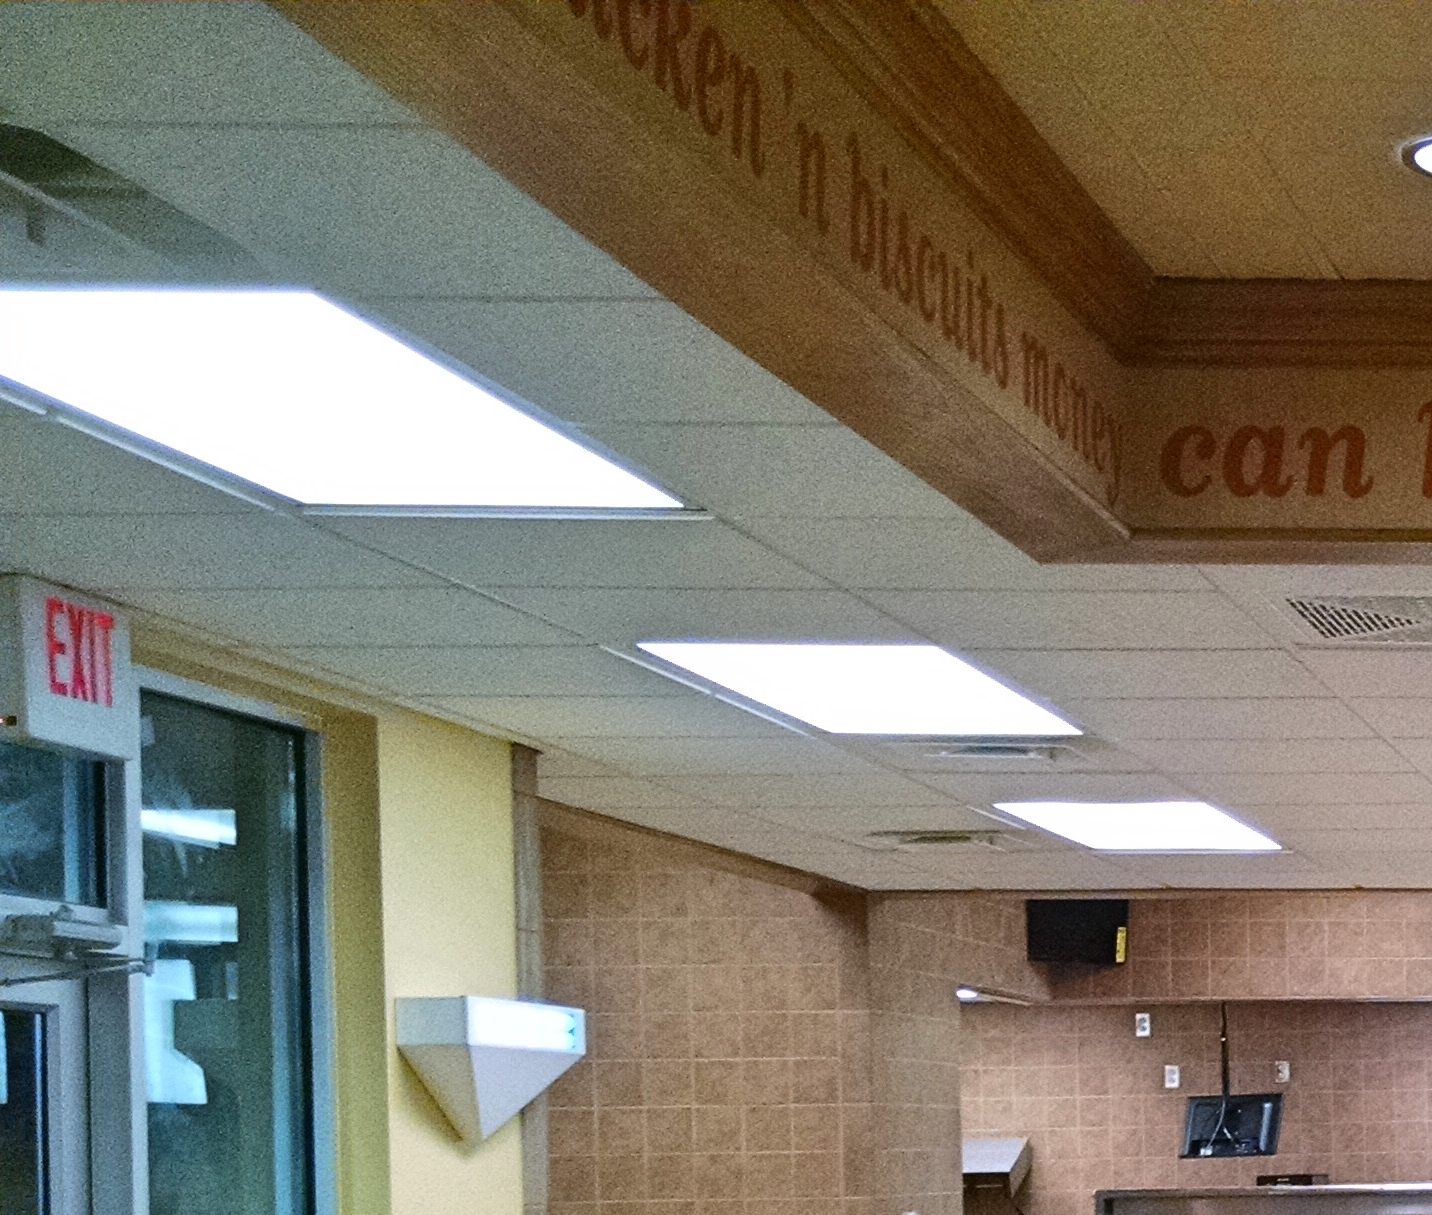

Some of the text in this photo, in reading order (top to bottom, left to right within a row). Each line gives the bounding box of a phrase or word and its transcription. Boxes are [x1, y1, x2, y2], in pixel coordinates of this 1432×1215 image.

[567, 0, 766, 178] cken
[846, 130, 1008, 390] biscuits
[1158, 423, 1374, 500] can
[45, 595, 114, 708] EXIT
